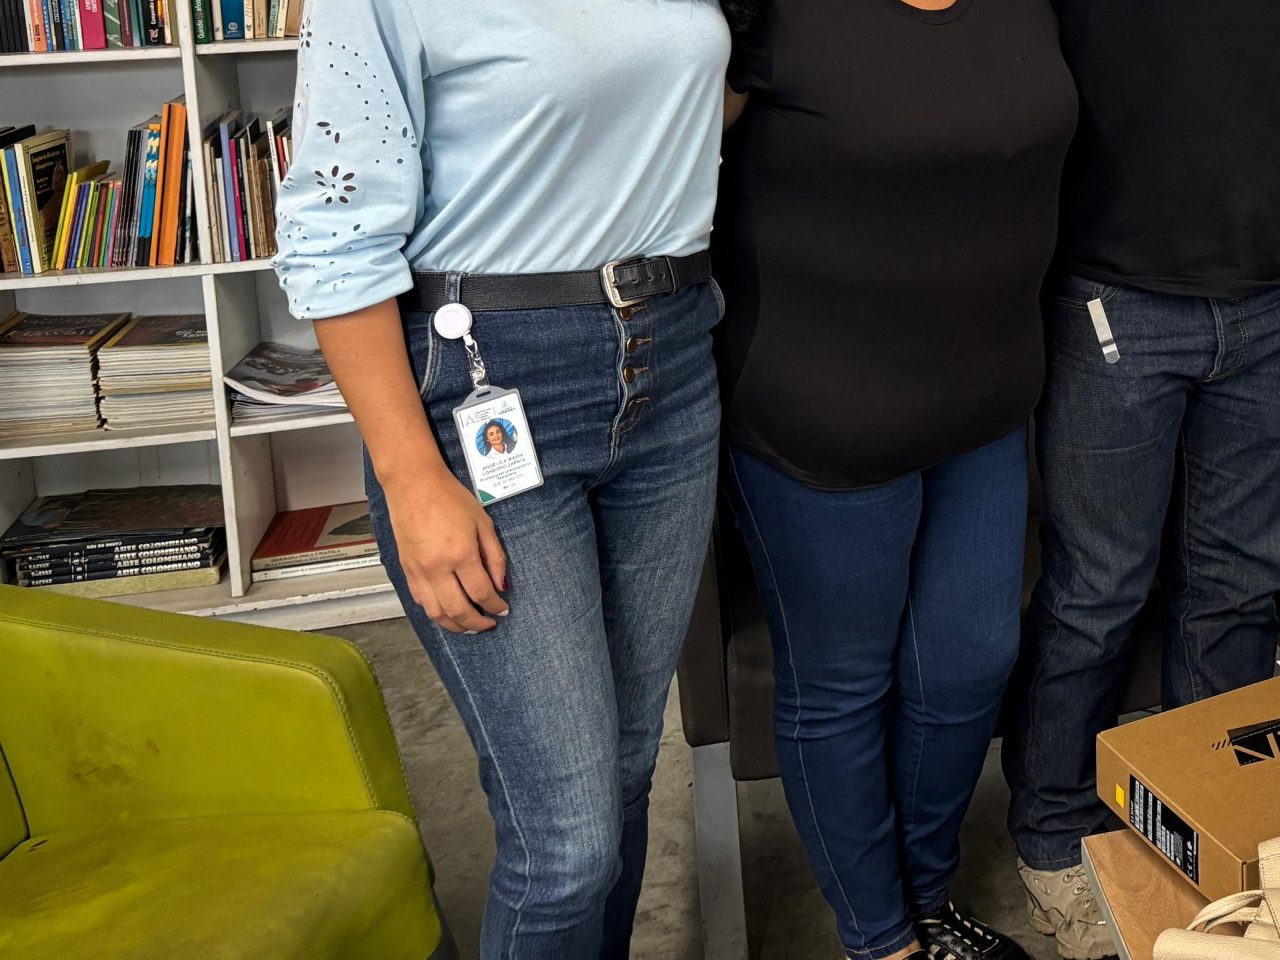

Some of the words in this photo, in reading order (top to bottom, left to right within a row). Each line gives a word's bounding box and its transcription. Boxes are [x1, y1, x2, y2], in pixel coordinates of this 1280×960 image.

[148, 1, 157, 25] Compendio
[113, 544, 137, 553] ARTE
[113, 552, 137, 561] ARTE
[138, 545, 198, 559] COLOMBIANO
[116, 559, 140, 568] ARTE
[140, 552, 201, 565] COLOMBIANO
[116, 567, 140, 577] ARTE
[140, 561, 201, 574] COLOMBIANO
